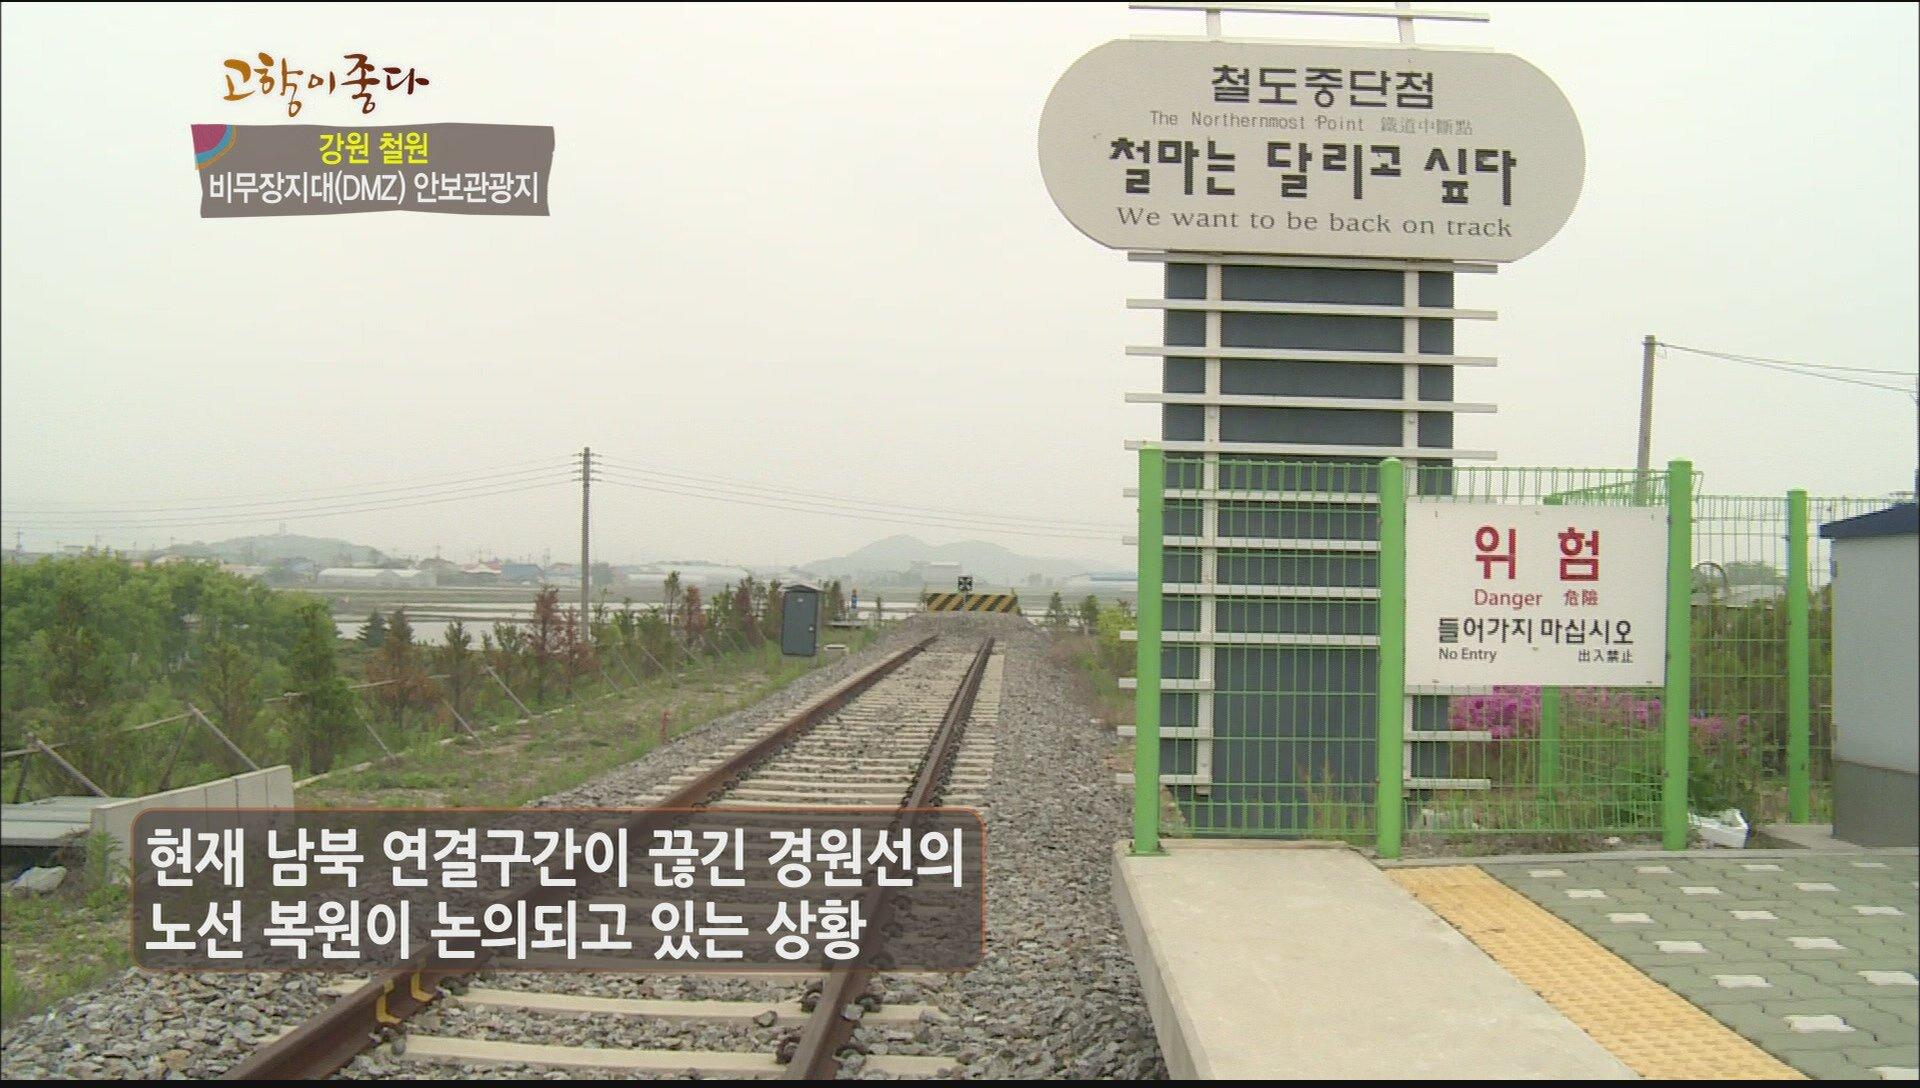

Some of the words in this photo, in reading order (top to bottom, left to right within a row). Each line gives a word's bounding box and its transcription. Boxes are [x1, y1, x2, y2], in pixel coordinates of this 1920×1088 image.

[1211, 65, 1435, 110] 철도중단점
[1150, 110, 1179, 126] The
[1191, 111, 1306, 131] Northernmost
[1315, 115, 1365, 132] Point
[1109, 137, 1236, 196] 철마는
[1267, 141, 1401, 200] 달리고
[1424, 148, 1517, 206] 싶다
[1117, 206, 1161, 227] We
[1173, 210, 1239, 229] want
[1249, 212, 1275, 230] to
[1286, 211, 1318, 231] be
[1329, 212, 1392, 234] back
[1402, 218, 1435, 236] on
[1446, 217, 1512, 238] track
[1474, 588, 1543, 609] Danger
[1563, 589, 1599, 606] 危險
[1438, 617, 1533, 644] 들어가지
[1540, 618, 1634, 645] 마십시오
[1438, 648, 1457, 660] No
[1461, 648, 1497, 664] Entry
[1578, 648, 1634, 664] 出入禁止
